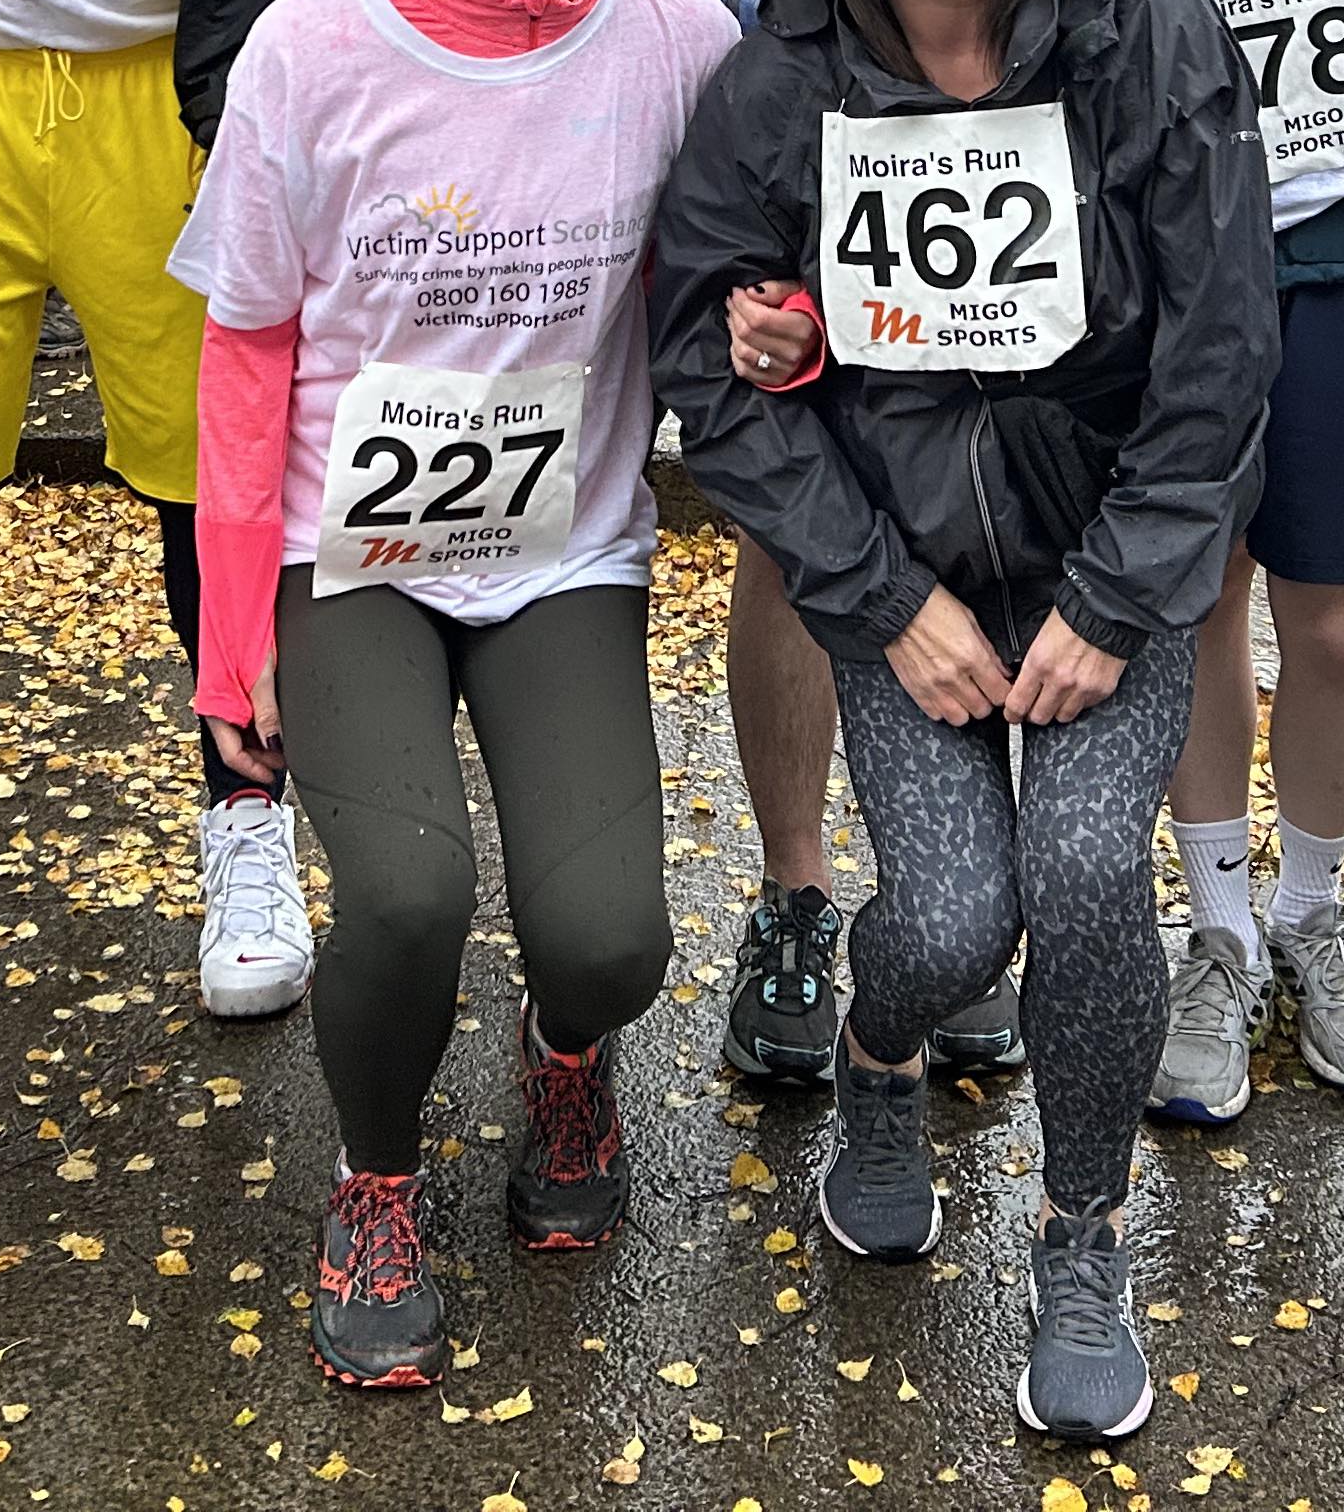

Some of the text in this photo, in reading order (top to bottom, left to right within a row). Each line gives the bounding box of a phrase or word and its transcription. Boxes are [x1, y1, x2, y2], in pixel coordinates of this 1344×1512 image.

[1284, 107, 1343, 134] MIGO
[849, 149, 1020, 178] Moira's Run
[347, 213, 648, 260] Victim Support Scotand
[836, 181, 1058, 289] 462
[422, 266, 463, 281] crime
[467, 264, 485, 280] by
[489, 259, 544, 277] making
[548, 253, 595, 276] people
[417, 277, 590, 308] 0800 160 1985
[414, 304, 586, 329] victimsupport.scot
[950, 300, 1017, 321] MIGO
[937, 325, 1037, 346] SPORTS
[381, 400, 543, 431] Moira's Run
[344, 427, 565, 528] 227
[447, 527, 512, 545] MIGO
[427, 545, 520, 564] SPORTS
